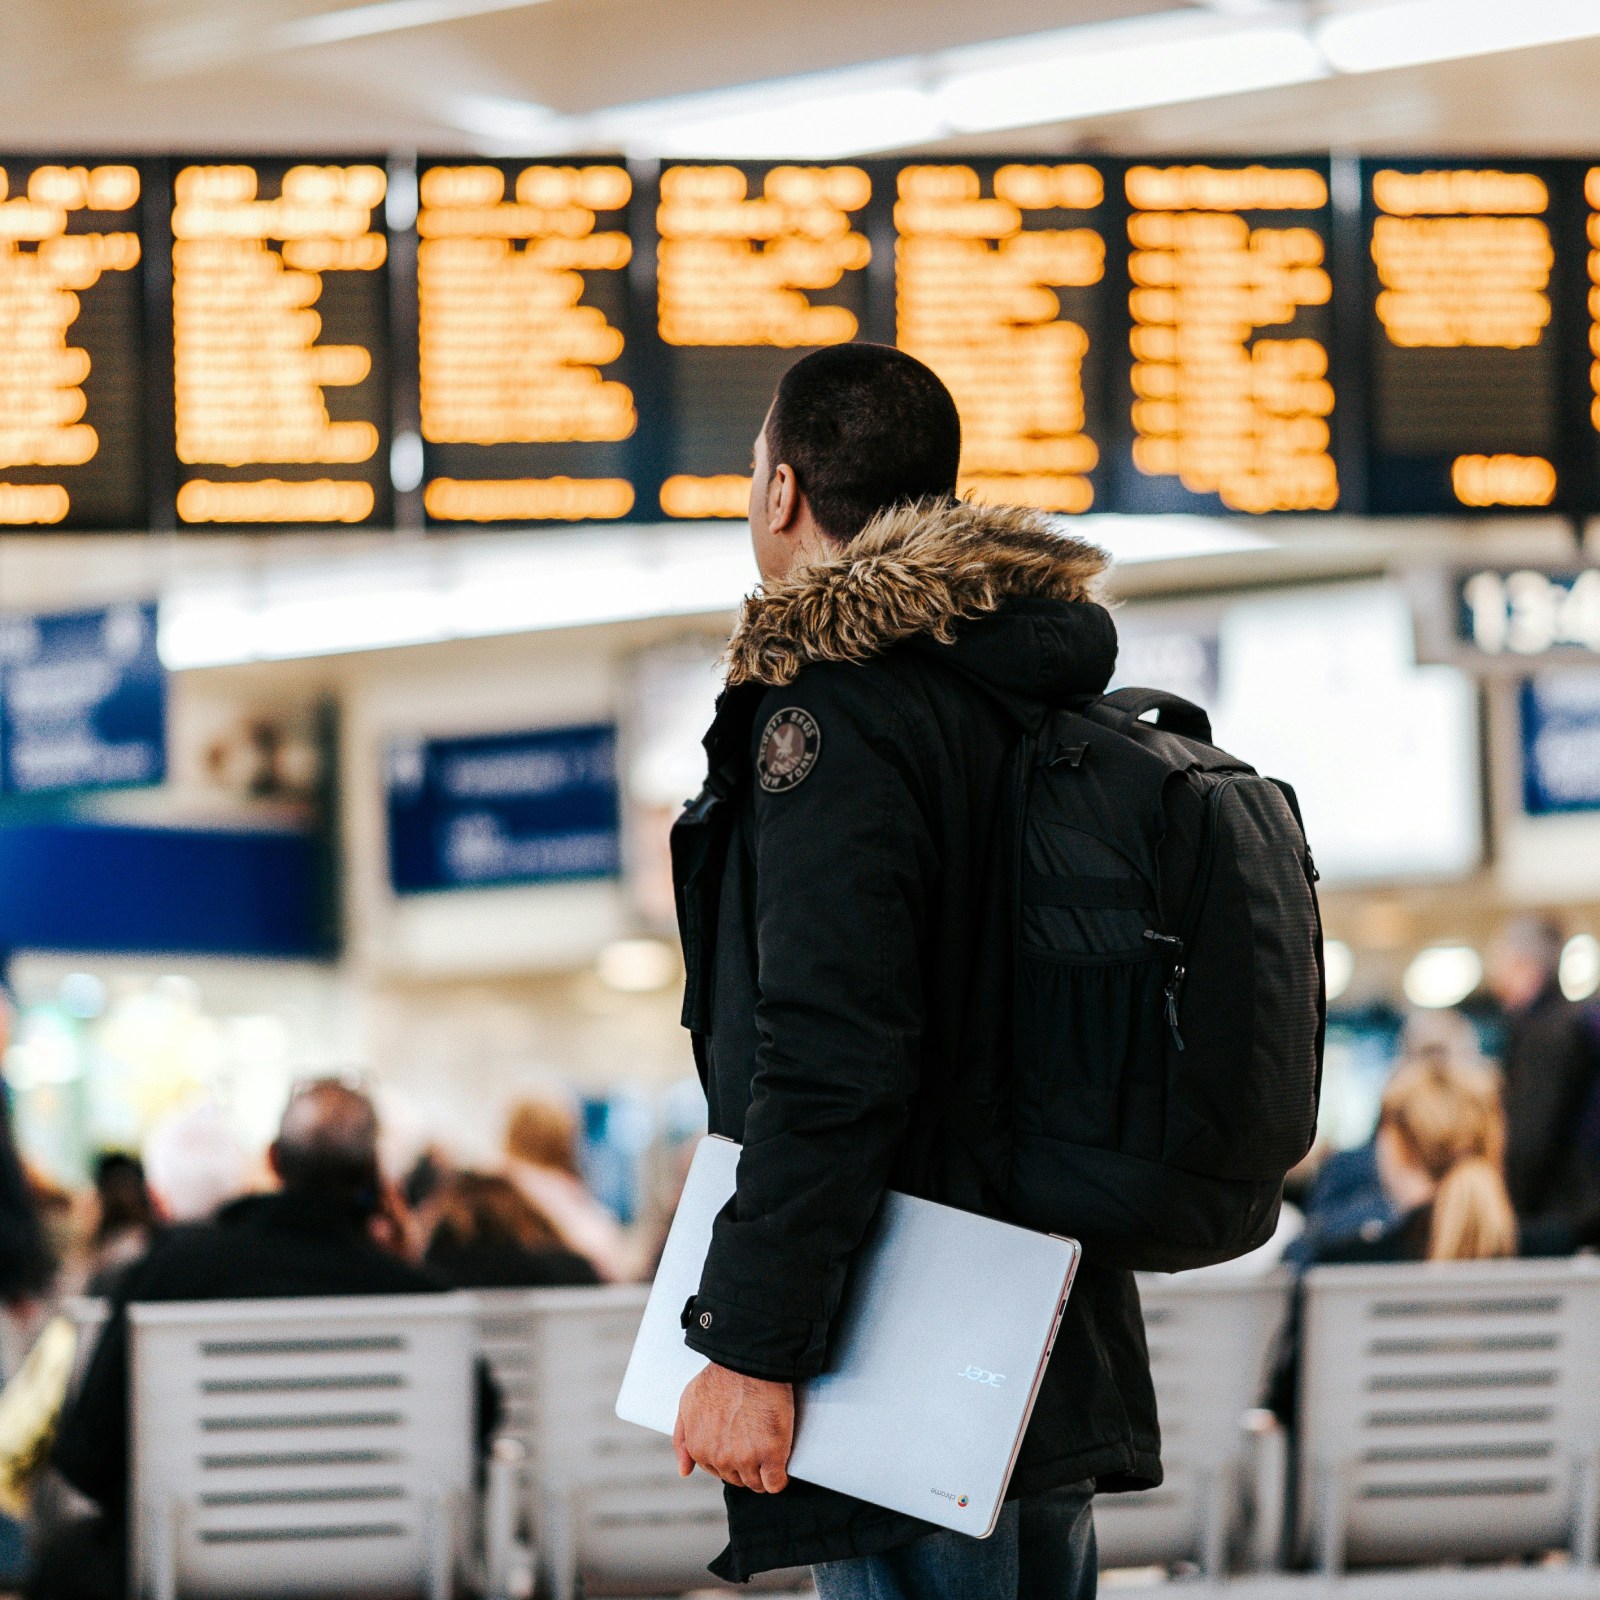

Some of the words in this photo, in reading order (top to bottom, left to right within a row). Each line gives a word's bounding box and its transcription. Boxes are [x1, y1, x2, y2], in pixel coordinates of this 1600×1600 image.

[790, 711, 816, 739] BROS
[785, 751, 815, 783] YORK
[957, 1364, 1007, 1388] acer
[930, 1487, 957, 1501] chrome
